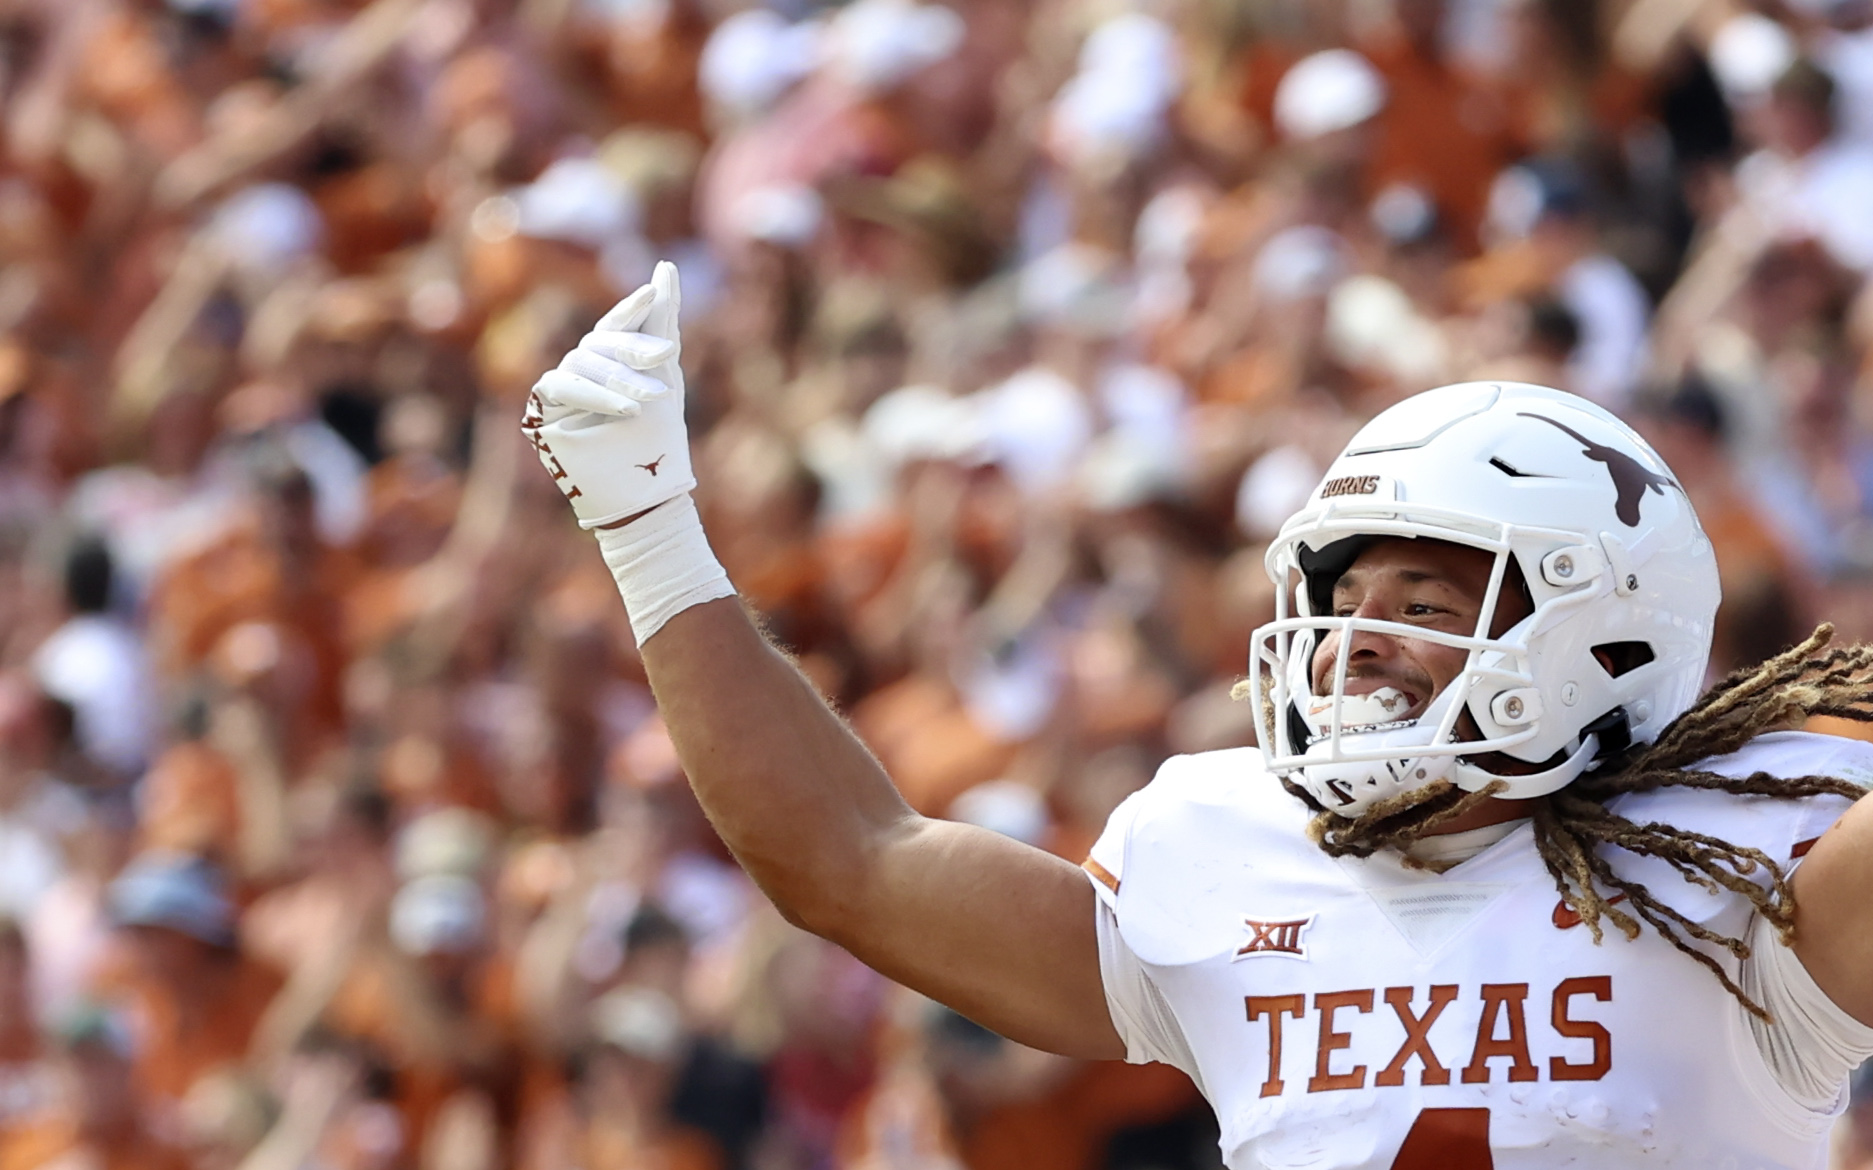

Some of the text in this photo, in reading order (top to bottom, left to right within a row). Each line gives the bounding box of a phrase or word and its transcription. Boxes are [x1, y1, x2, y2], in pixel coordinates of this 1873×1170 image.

[1320, 475, 1380, 499] HORNS
[1237, 917, 1311, 956] XII
[1245, 975, 1612, 1099] TEXAS
